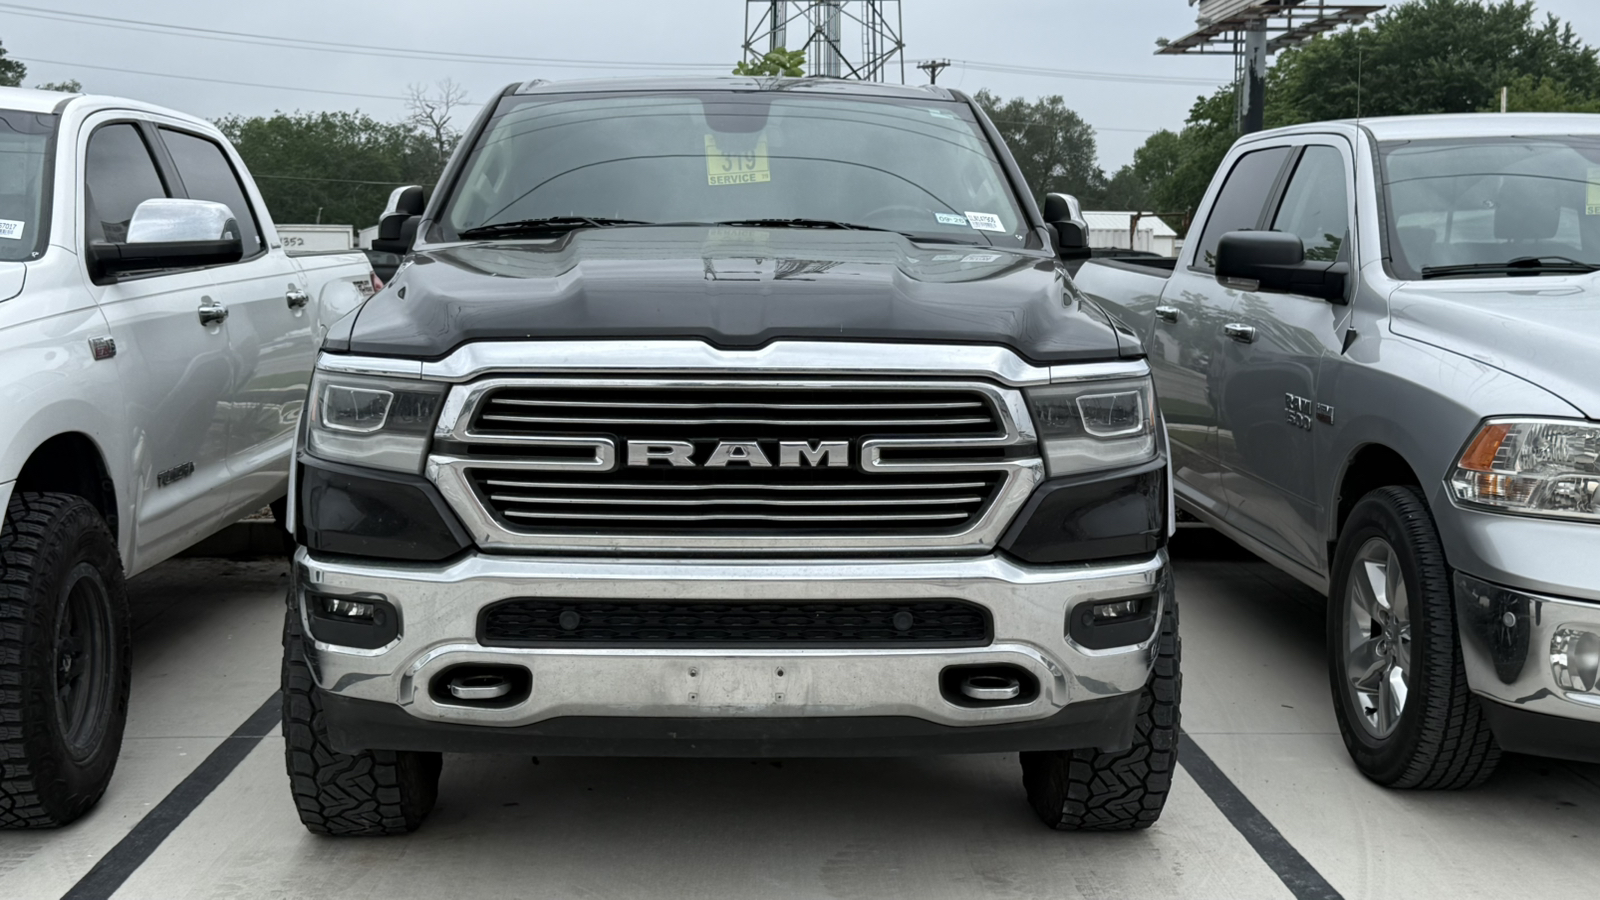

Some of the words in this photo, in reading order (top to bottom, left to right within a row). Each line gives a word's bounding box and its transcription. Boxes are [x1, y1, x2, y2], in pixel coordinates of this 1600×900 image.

[710, 173, 756, 185] SERVICE
[279, 237, 304, 247] 352
[1285, 392, 1312, 415] RAM
[627, 439, 850, 467] RAM
